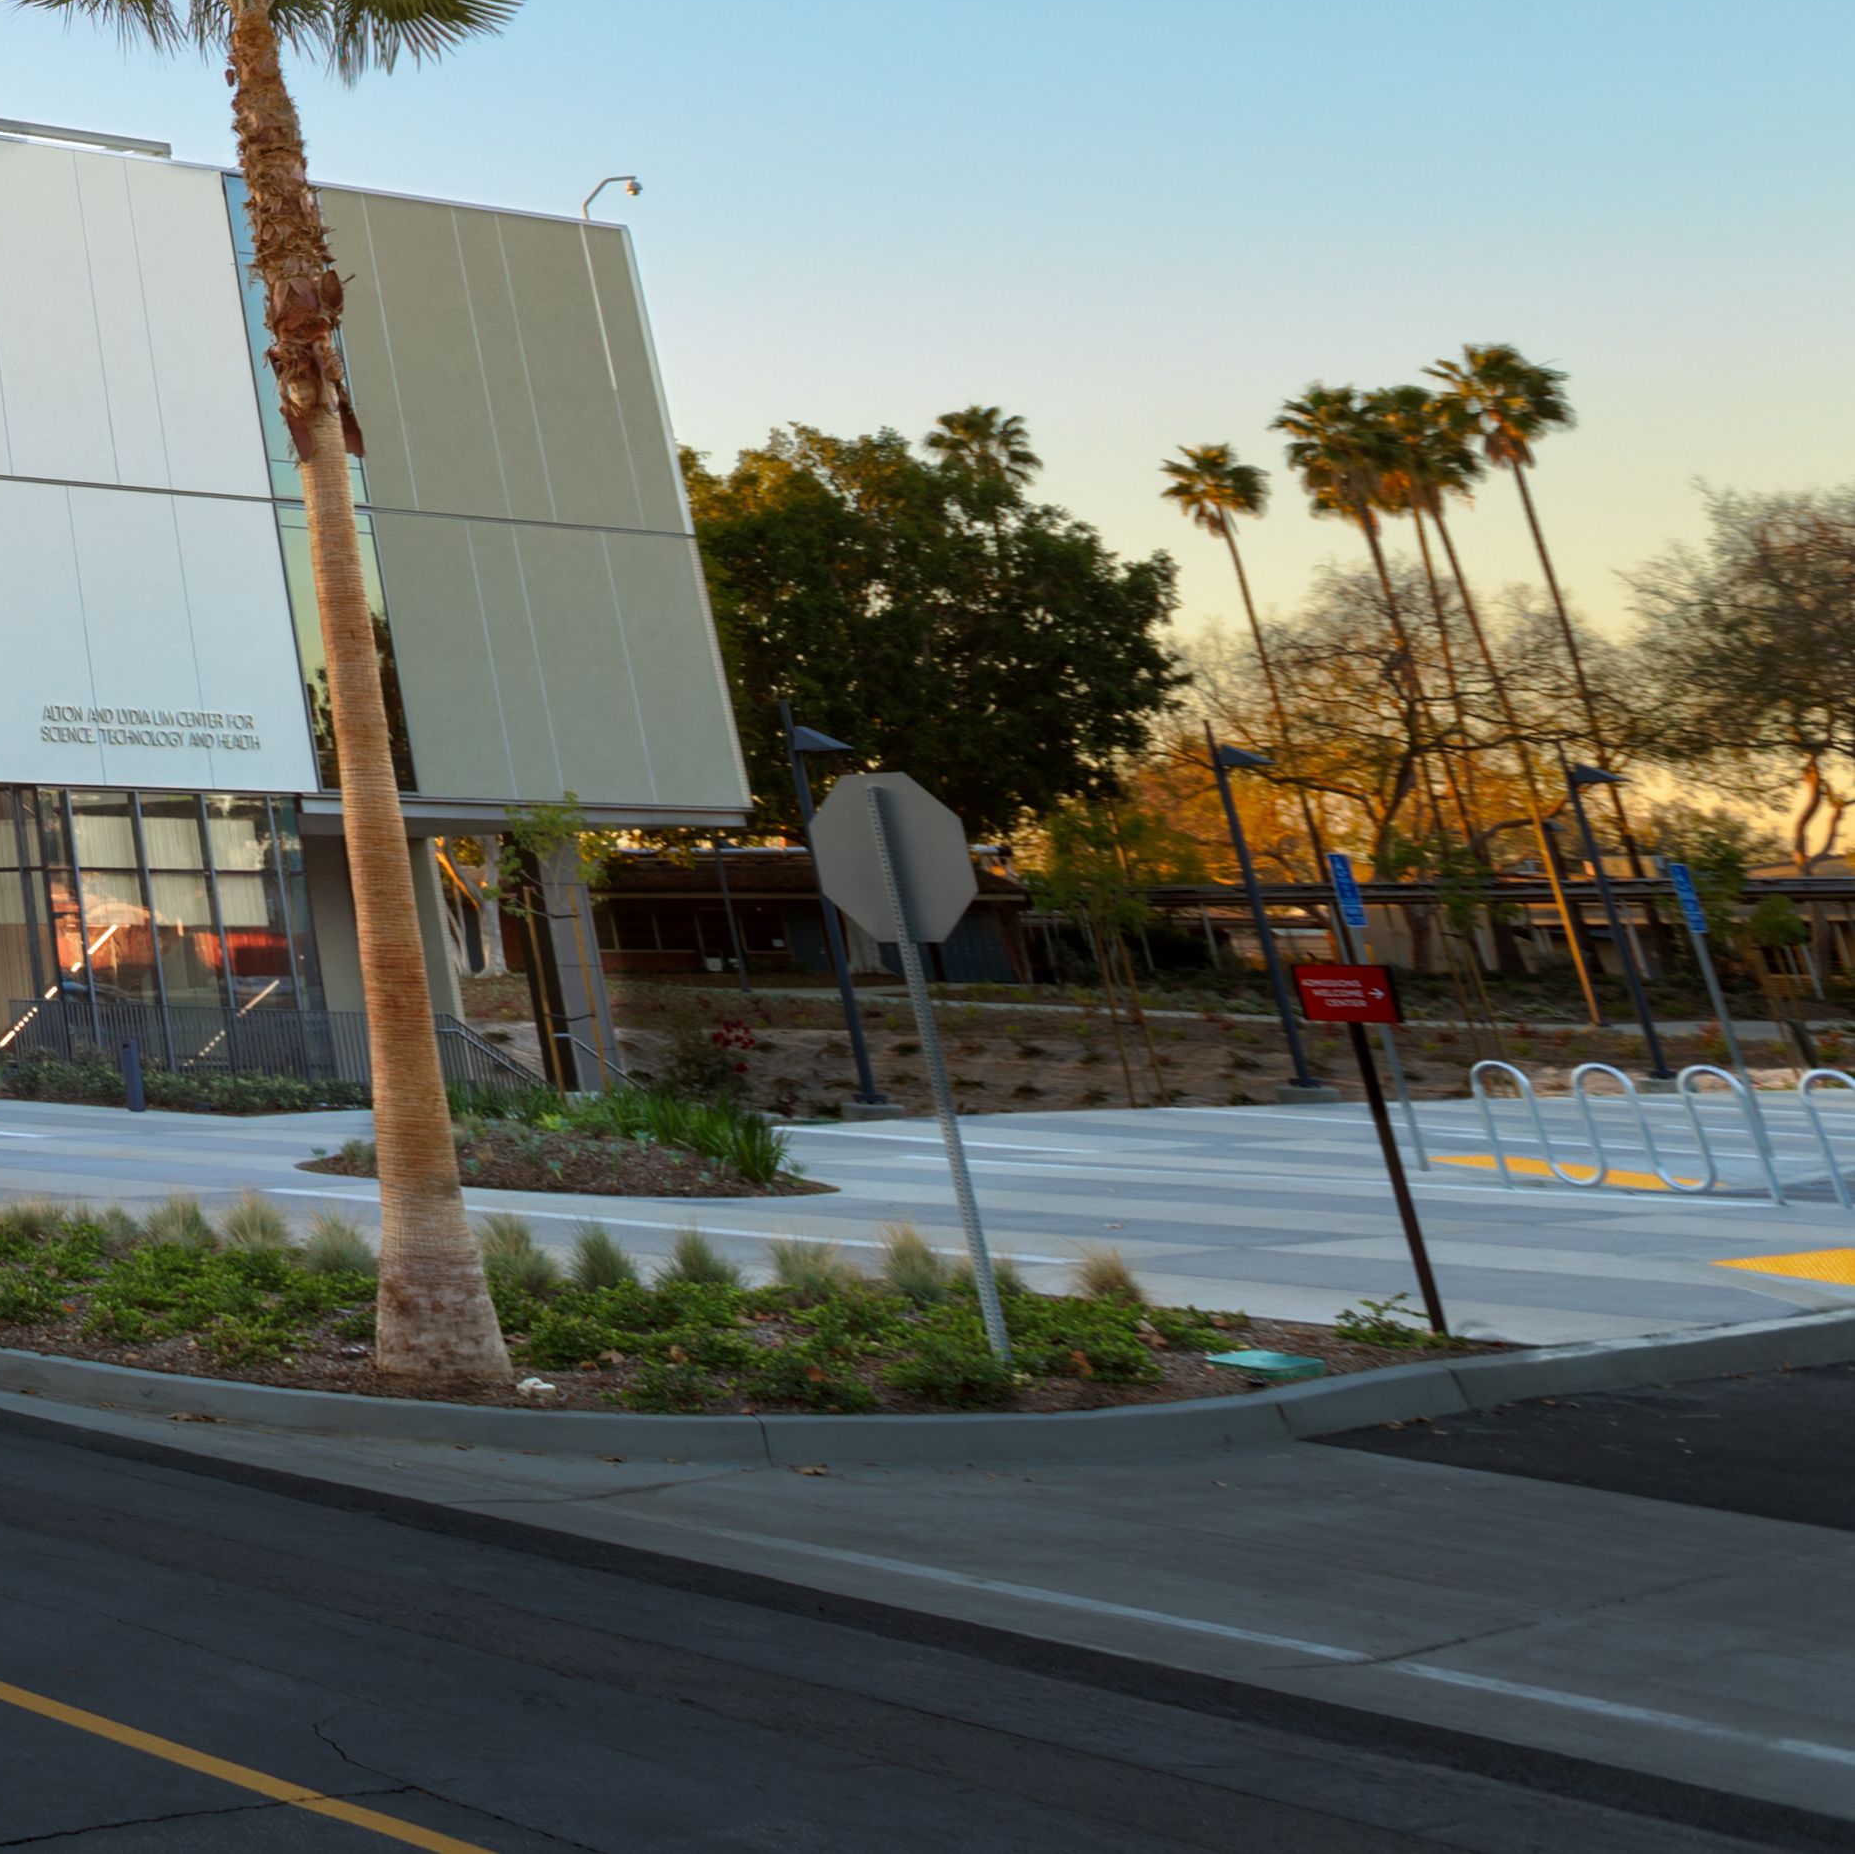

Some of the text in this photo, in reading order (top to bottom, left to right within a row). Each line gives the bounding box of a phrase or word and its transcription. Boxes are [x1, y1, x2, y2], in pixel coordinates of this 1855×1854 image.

[43, 705, 254, 730] ALTON AND LYDIA LIM CENTER FOR
[98, 728, 184, 747] TECHNOLOGY
[189, 731, 214, 749] AND
[216, 733, 261, 750] HEALTH
